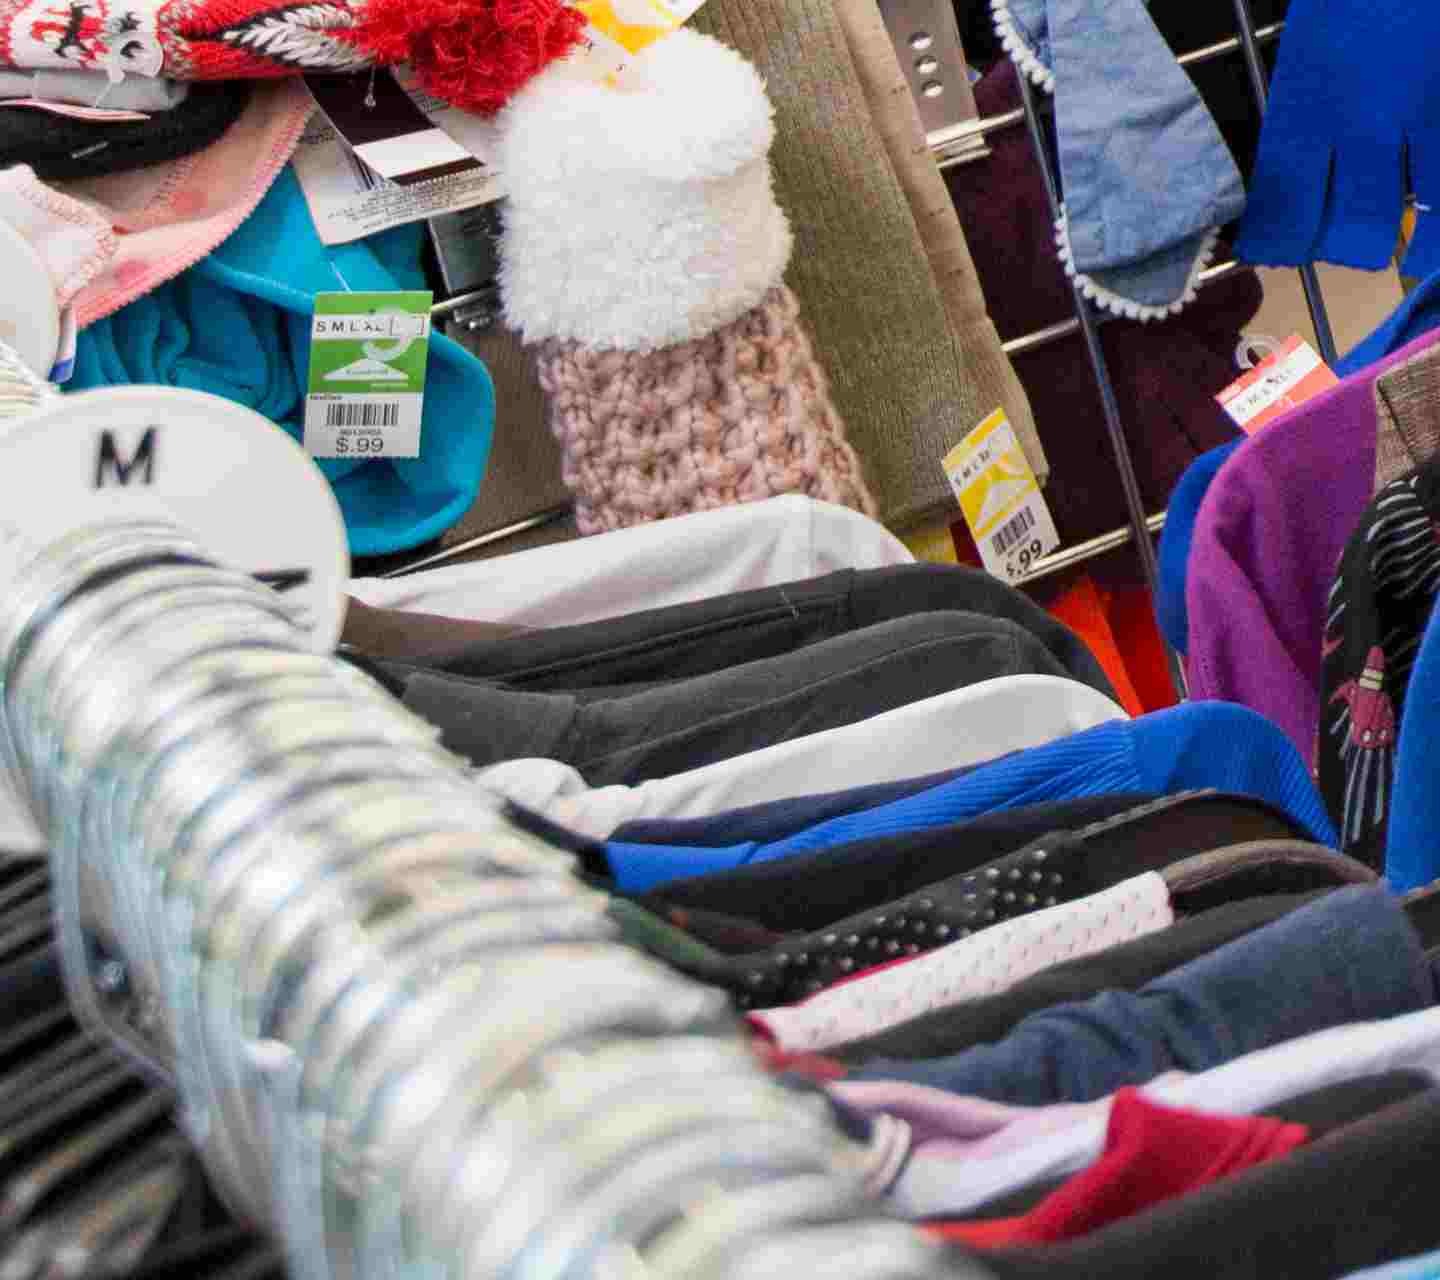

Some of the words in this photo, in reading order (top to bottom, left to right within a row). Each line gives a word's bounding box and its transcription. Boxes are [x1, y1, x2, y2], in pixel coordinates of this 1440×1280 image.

[331, 319, 345, 333] M
[335, 436, 384, 454] $.99
[94, 425, 158, 490] M
